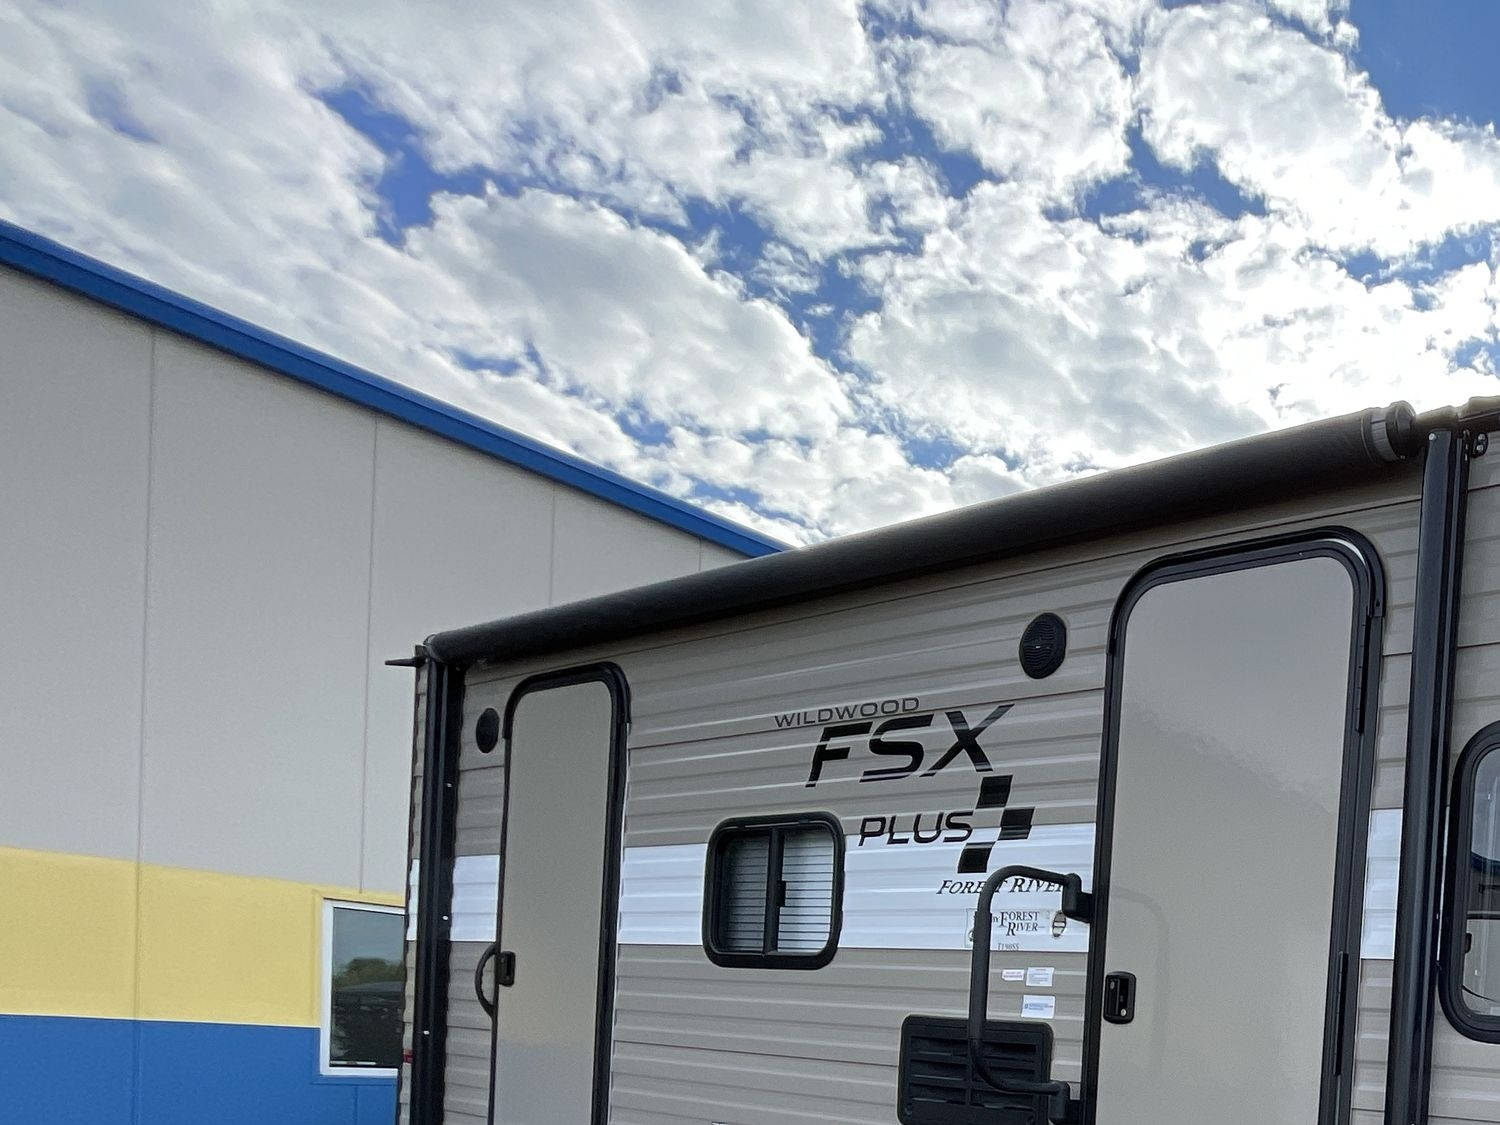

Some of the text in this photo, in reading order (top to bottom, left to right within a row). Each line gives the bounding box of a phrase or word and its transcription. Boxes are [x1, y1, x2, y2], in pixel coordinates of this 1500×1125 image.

[774, 697, 920, 728] WILDWOOD
[805, 703, 1016, 788] FSX
[858, 810, 975, 846] PLUS
[1000, 911, 1040, 928] FOREST
[1005, 922, 1039, 936] RIVER
